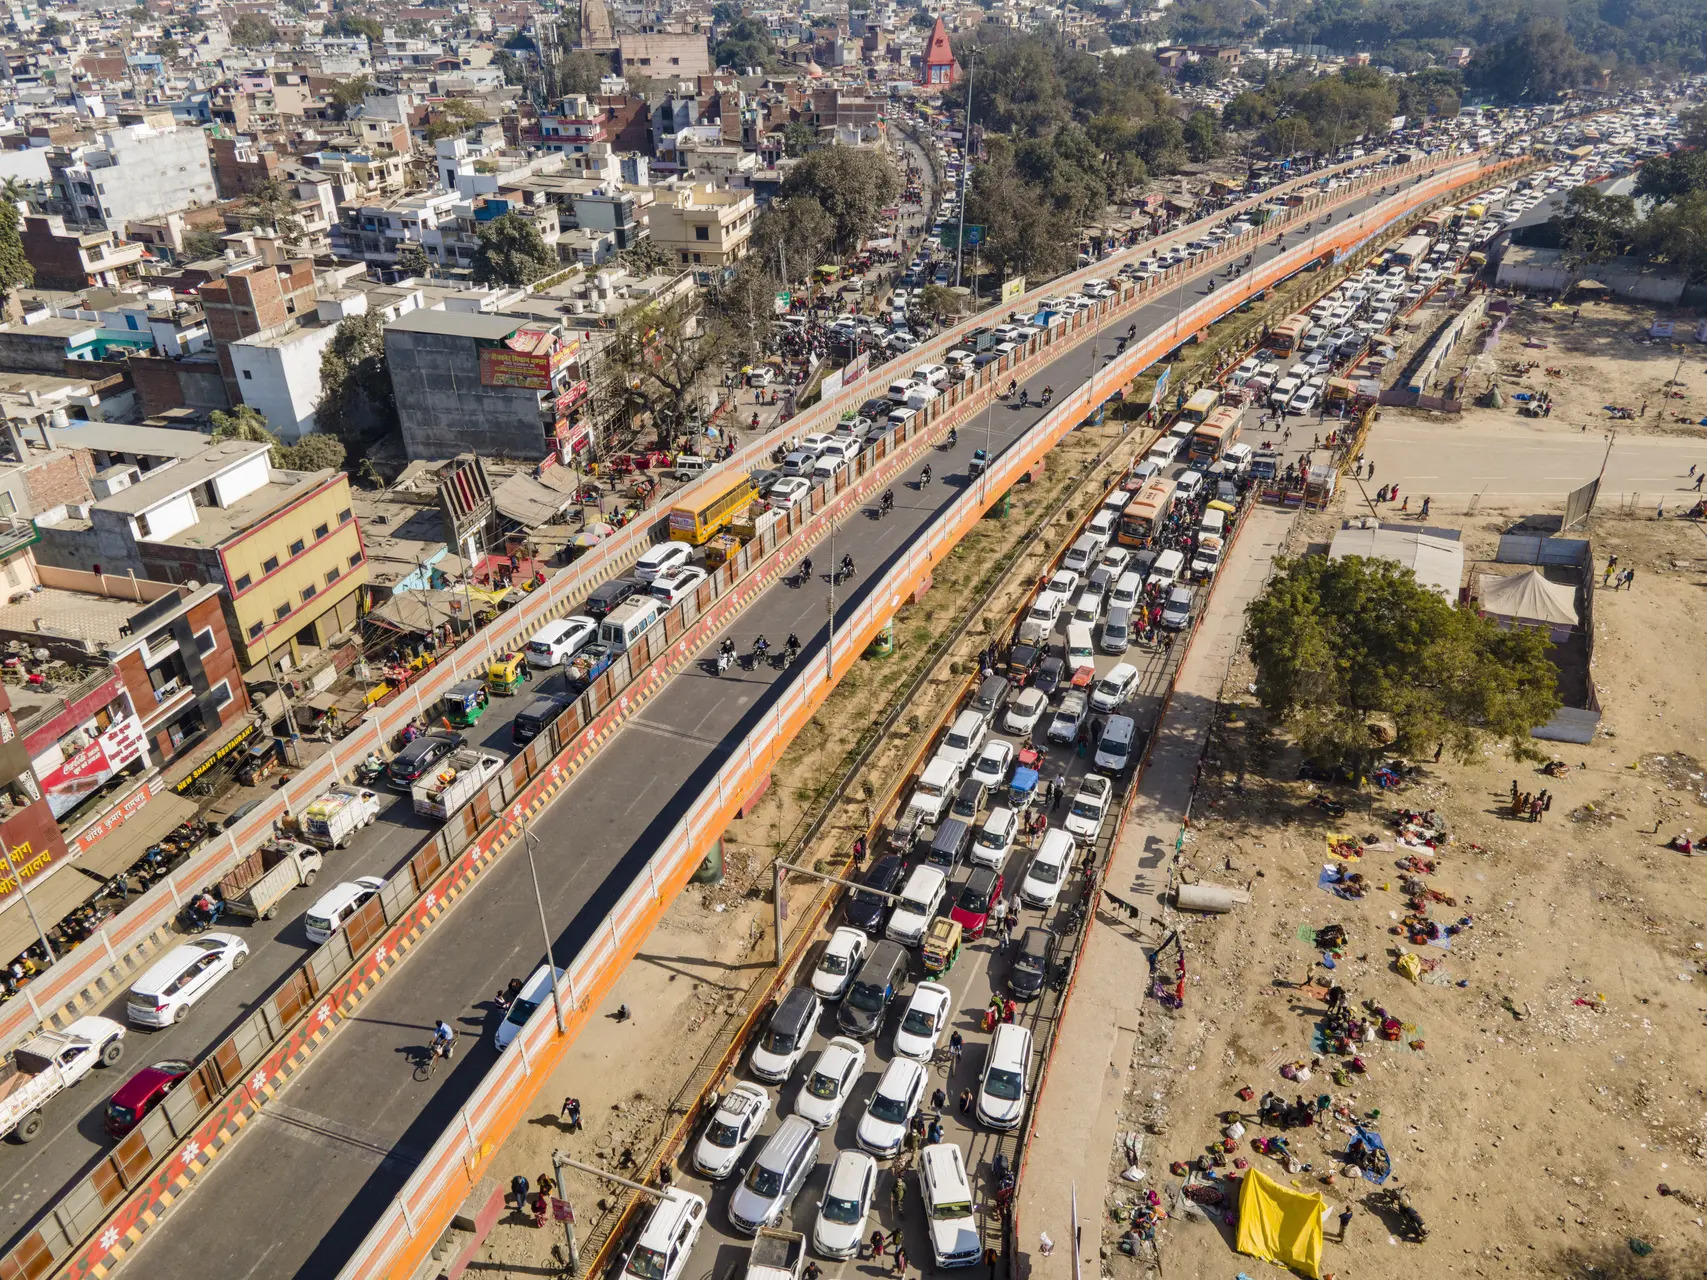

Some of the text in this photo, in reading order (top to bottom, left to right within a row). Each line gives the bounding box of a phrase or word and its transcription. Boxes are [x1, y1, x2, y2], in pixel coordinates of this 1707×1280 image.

[176, 725, 253, 792] NEW SHANTI RESTAURANT
